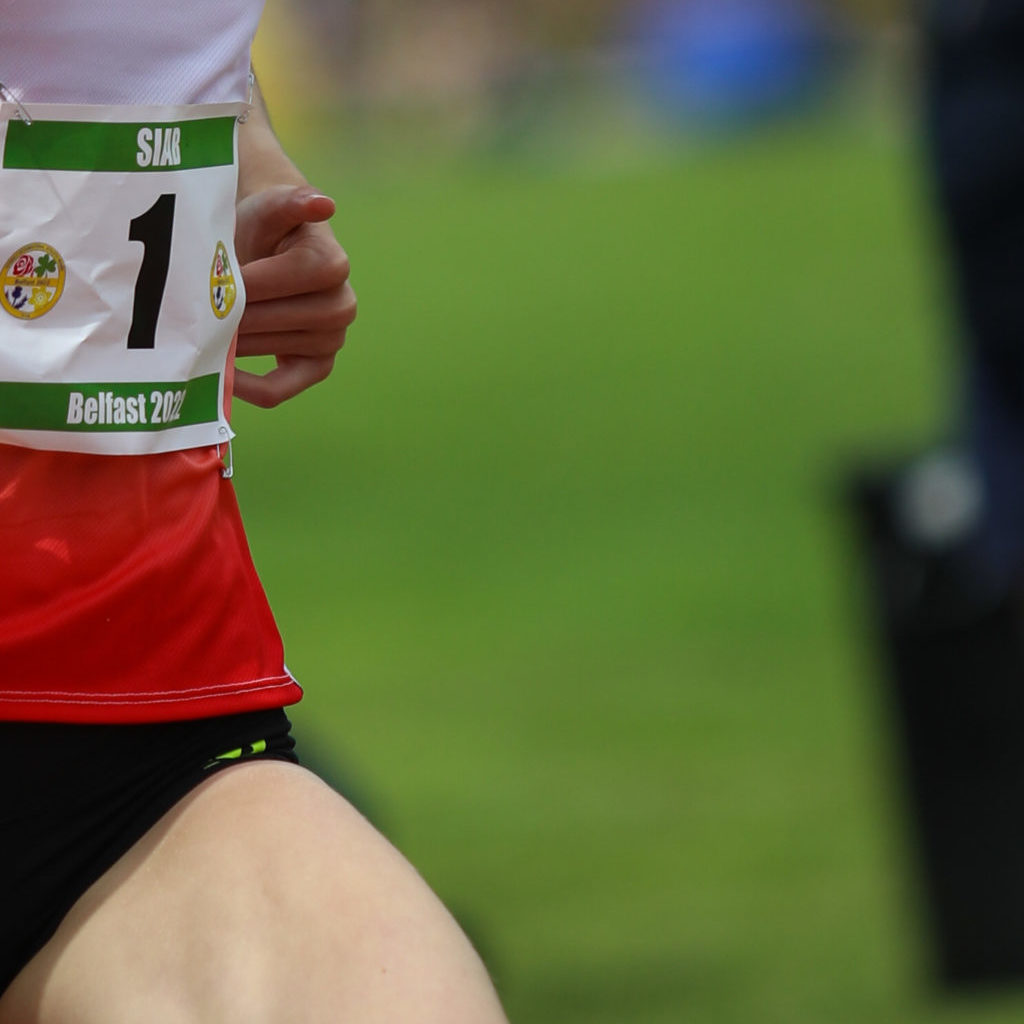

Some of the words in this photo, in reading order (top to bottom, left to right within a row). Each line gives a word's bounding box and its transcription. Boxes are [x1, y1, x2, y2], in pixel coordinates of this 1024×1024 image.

[137, 127, 181, 167] SIAB
[127, 193, 176, 349] 1
[66, 391, 147, 424] Belfast
